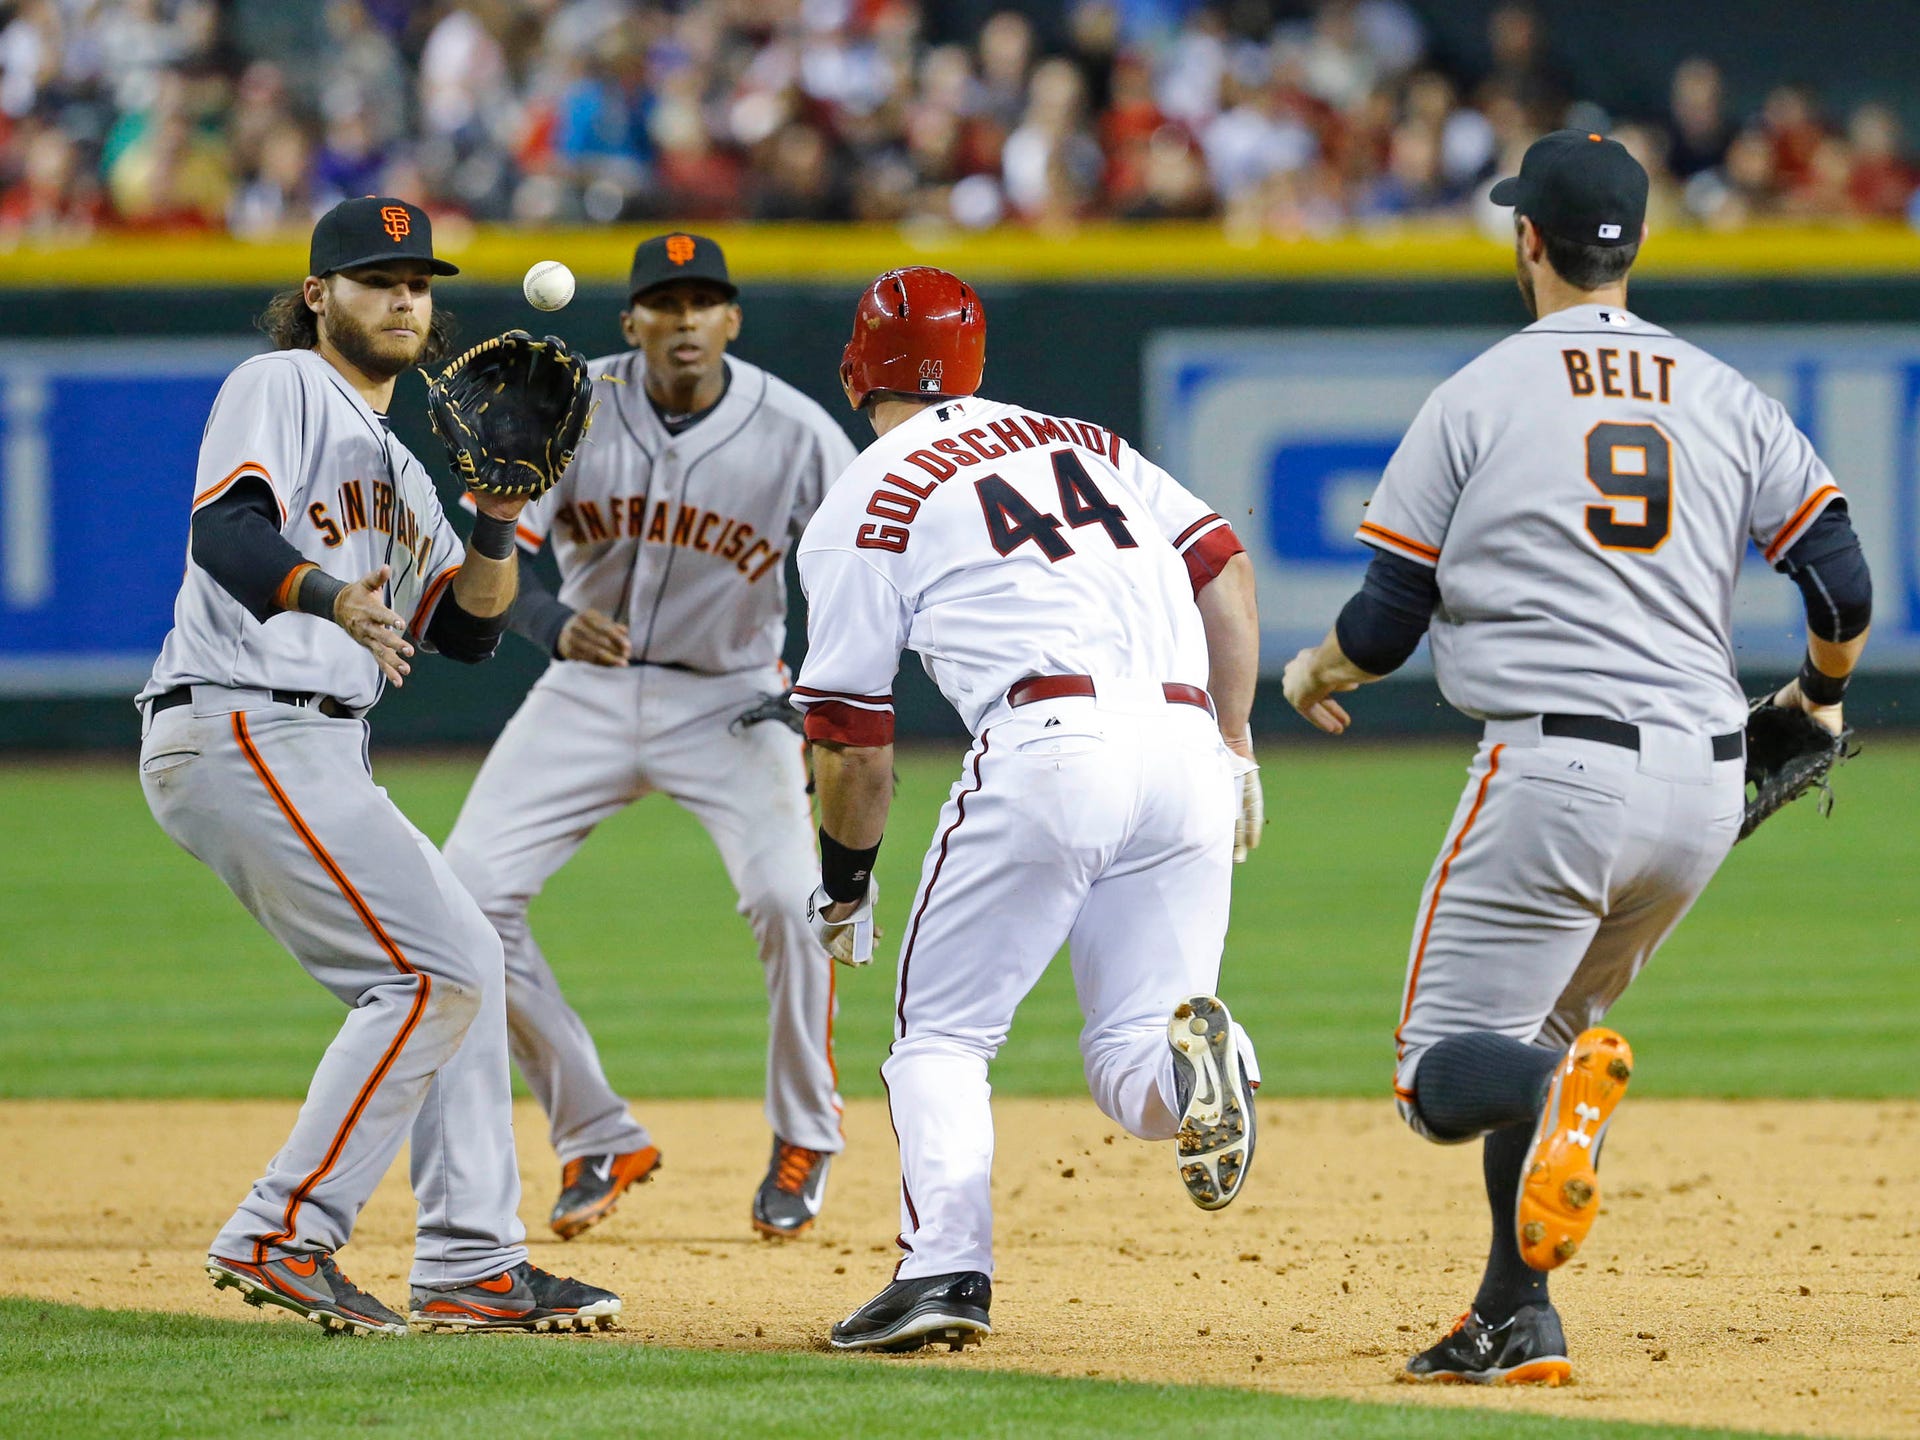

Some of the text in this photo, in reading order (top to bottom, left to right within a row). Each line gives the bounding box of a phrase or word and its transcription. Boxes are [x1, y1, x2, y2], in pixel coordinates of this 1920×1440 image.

[380, 206, 411, 242] SF
[919, 359, 943, 379] 44
[1561, 348, 1676, 404] BELT
[974, 448, 1139, 563] 44
[1584, 420, 1672, 554] 9
